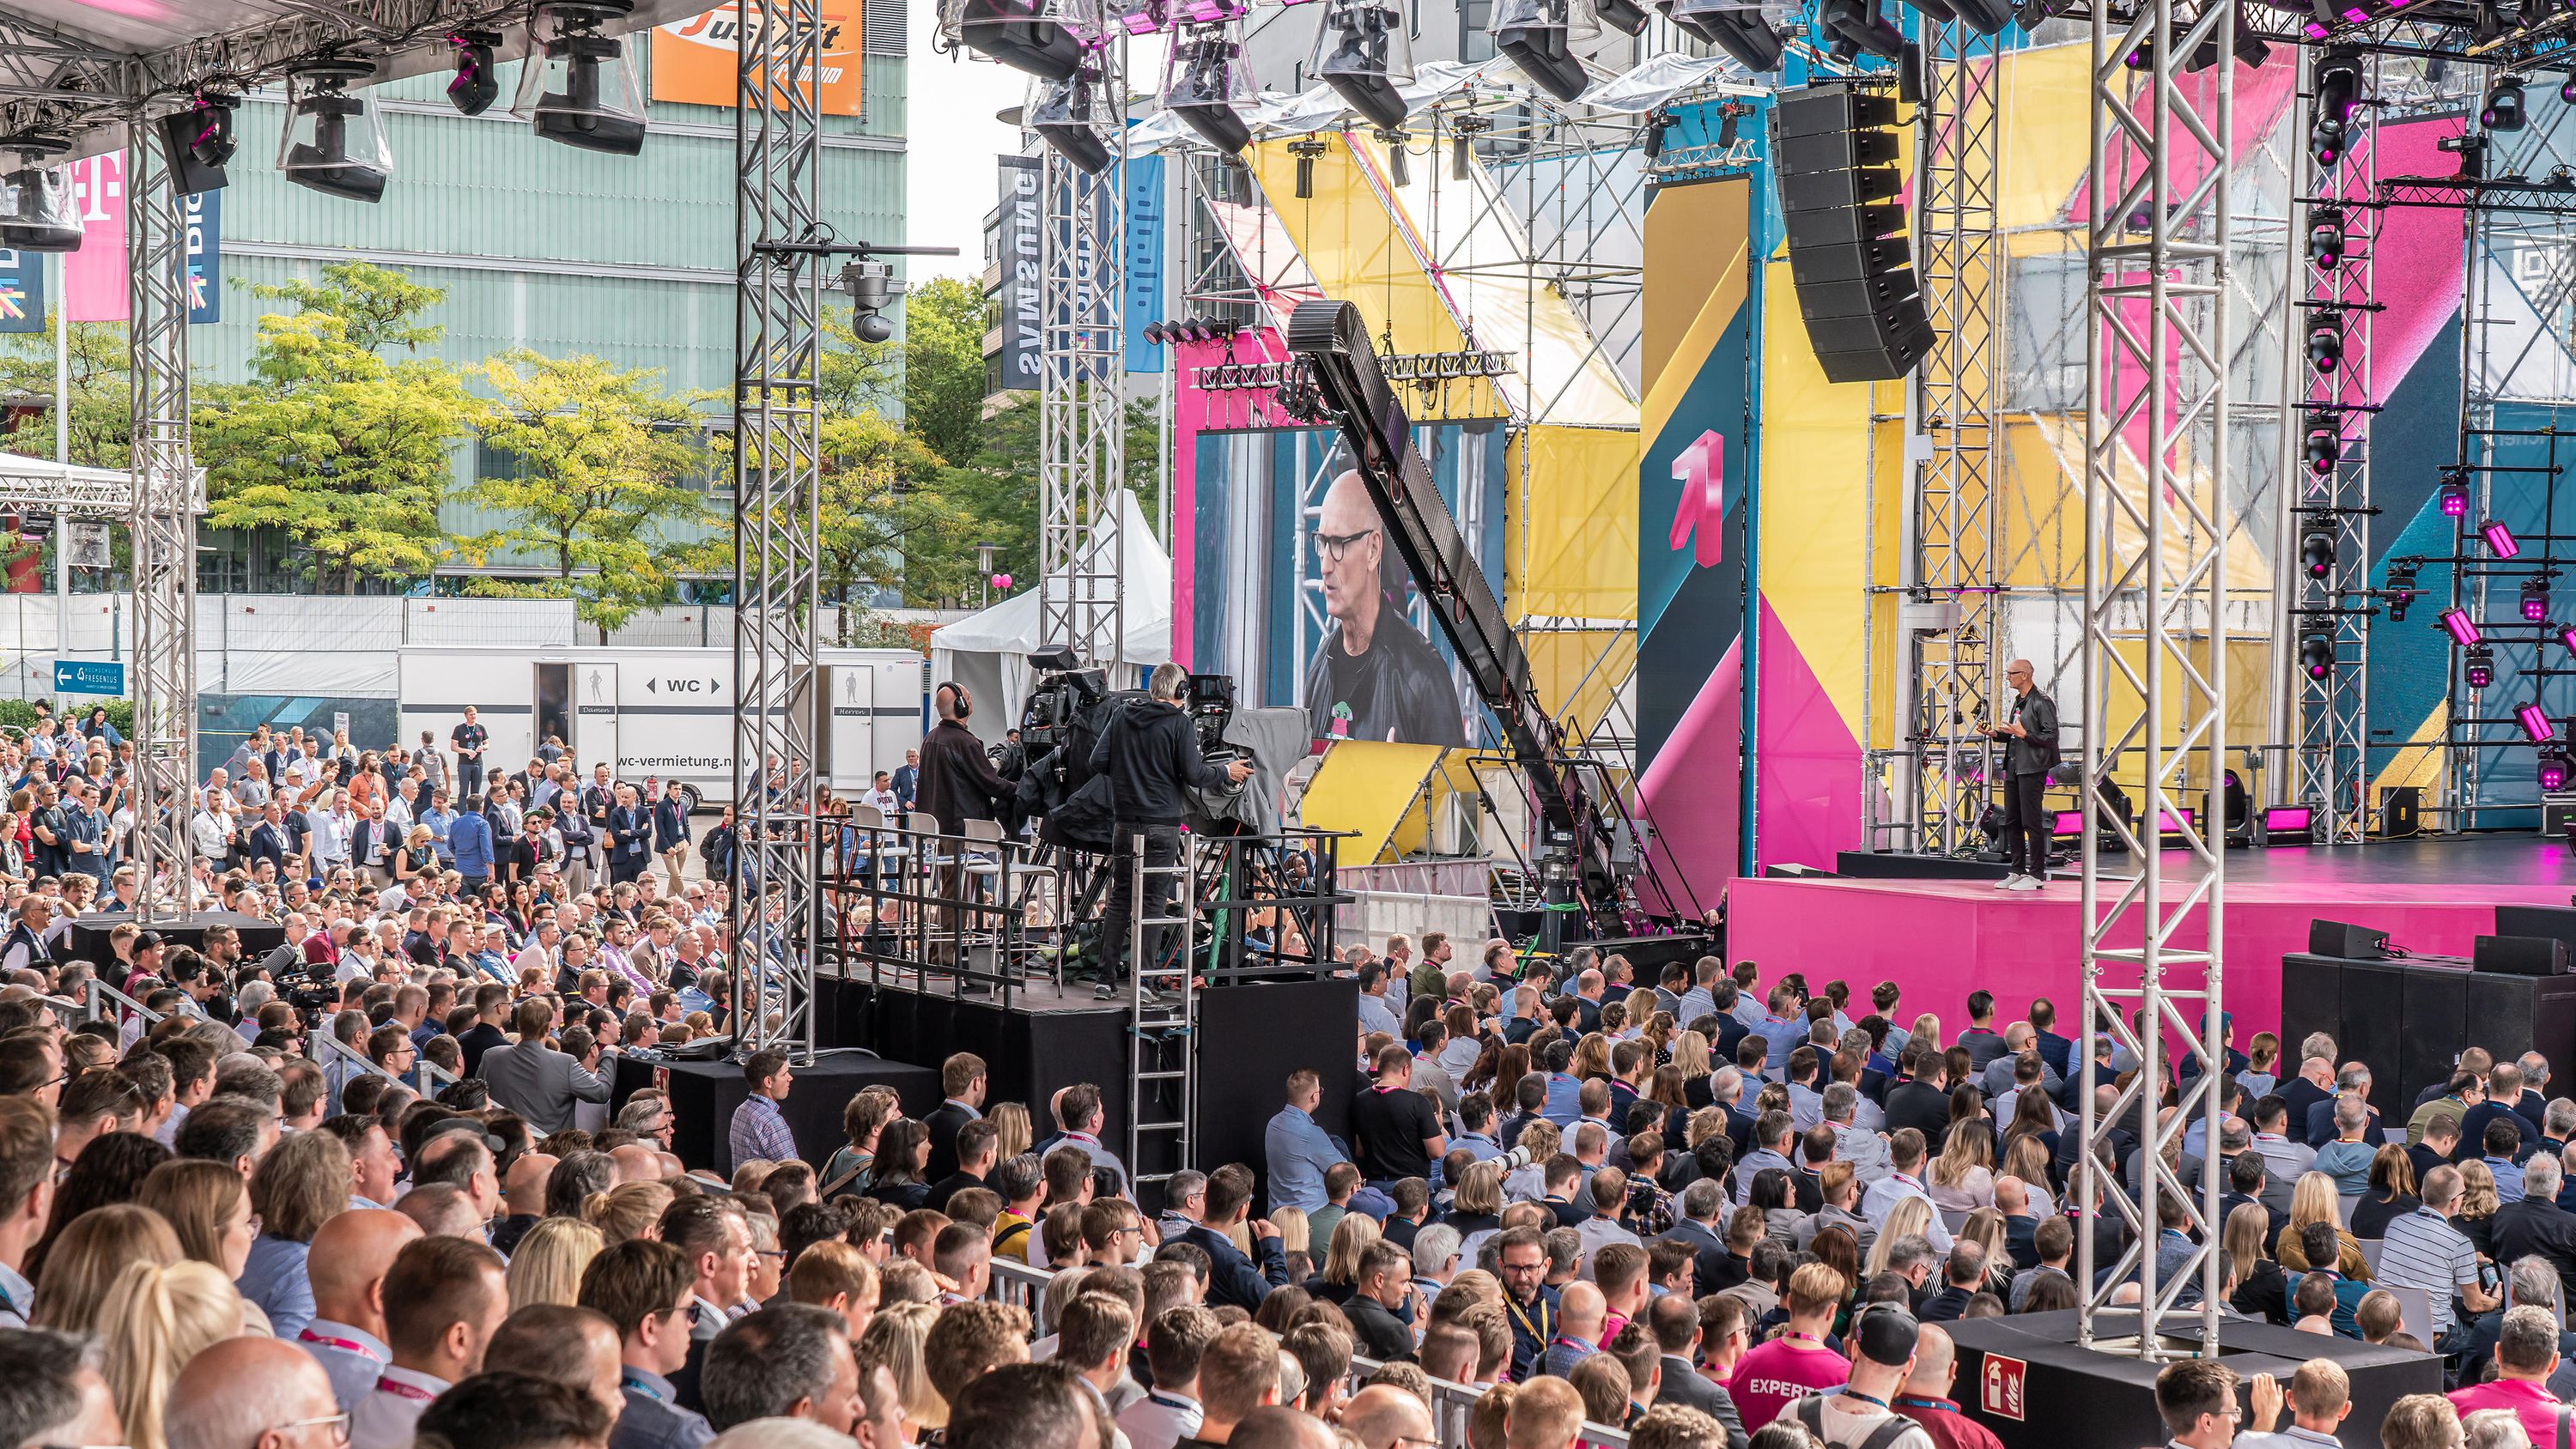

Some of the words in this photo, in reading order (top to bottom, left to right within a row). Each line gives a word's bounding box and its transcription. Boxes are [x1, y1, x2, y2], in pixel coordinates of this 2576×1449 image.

[678, 11, 776, 41] Jus
[85, 675, 117, 683] FRESENIUS
[667, 679, 701, 692] WC
[617, 755, 750, 769] wc-vermietung.nw
[1750, 1379, 1821, 1399] EXPERT
